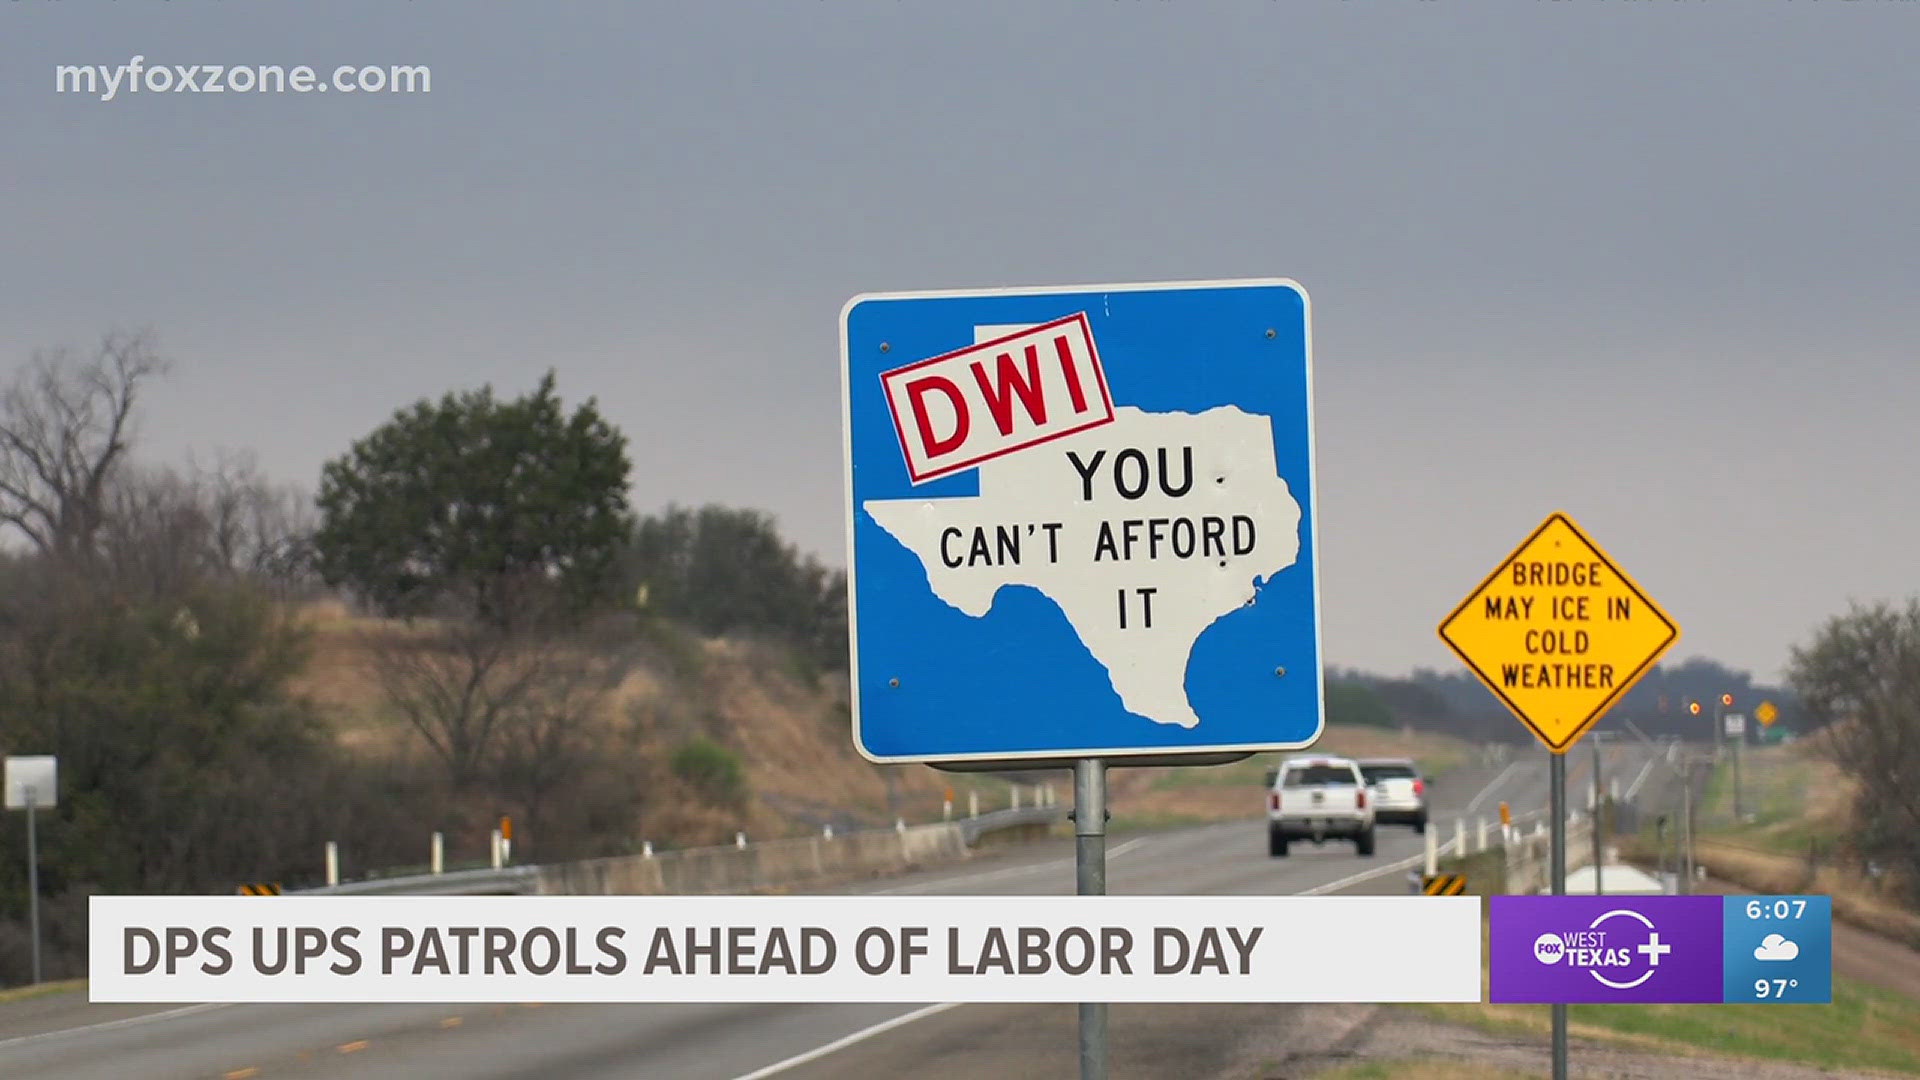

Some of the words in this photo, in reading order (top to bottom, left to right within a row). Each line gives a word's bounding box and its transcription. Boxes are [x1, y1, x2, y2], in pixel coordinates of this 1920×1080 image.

[905, 335, 1088, 459] DWI
[1066, 446, 1193, 500] YOU
[940, 523, 1063, 569] CAN'T
[1094, 515, 1256, 562] AFFORD
[1512, 562, 1602, 587] BRIDGE
[1118, 588, 1157, 629] IT
[1485, 596, 1534, 620] MAY
[1552, 596, 1590, 621] ICE
[1607, 597, 1631, 620] IN
[1525, 629, 1589, 655] COLD
[1502, 664, 1615, 689] WEATHER
